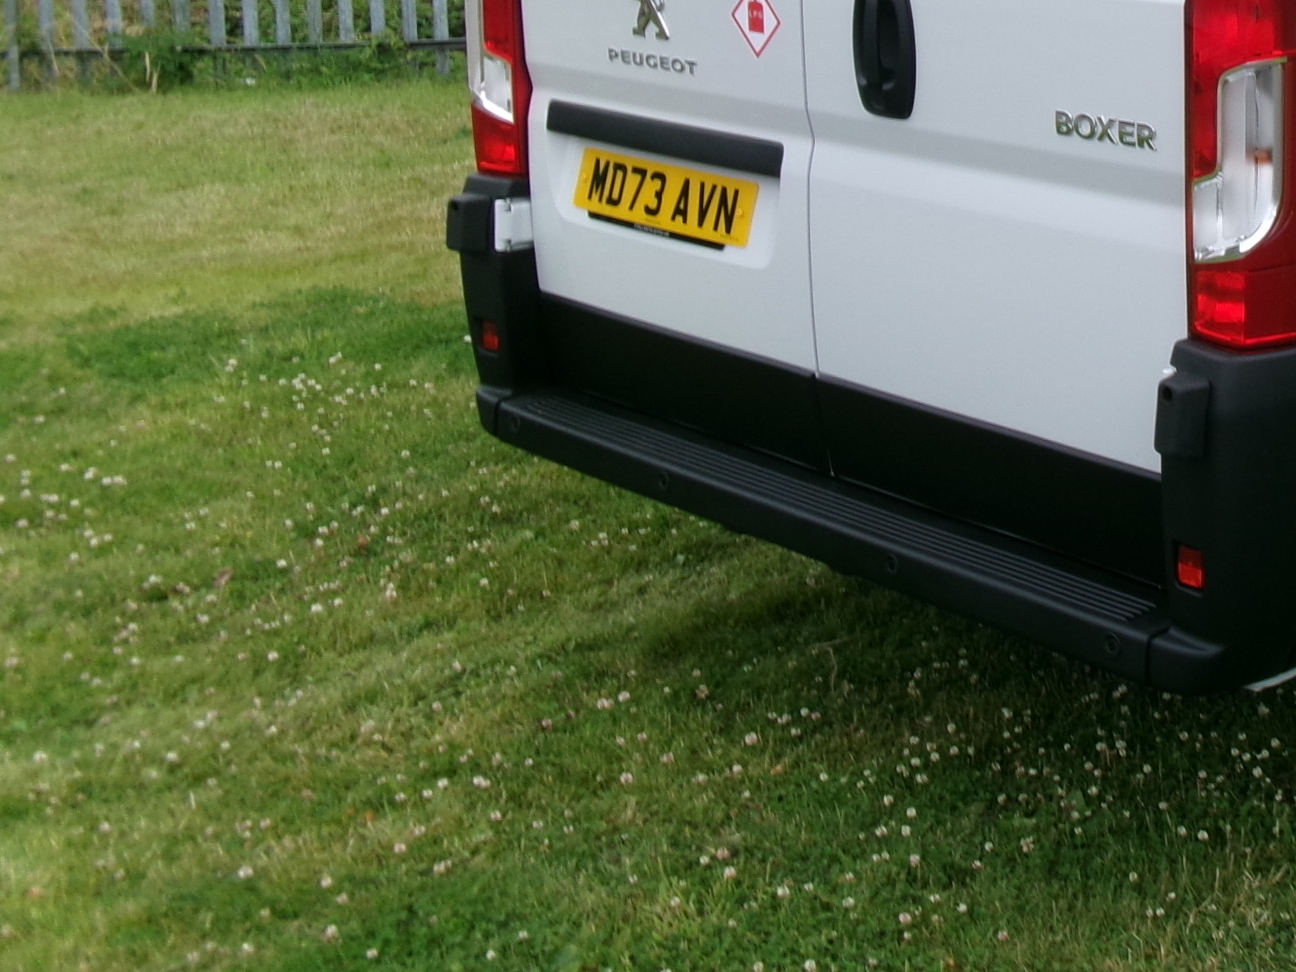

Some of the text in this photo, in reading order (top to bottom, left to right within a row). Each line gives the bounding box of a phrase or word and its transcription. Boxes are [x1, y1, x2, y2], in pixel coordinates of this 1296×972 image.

[608, 47, 697, 75] PEUGEOT
[1055, 109, 1157, 151] BOXER
[588, 157, 739, 235] MD73 AVN
